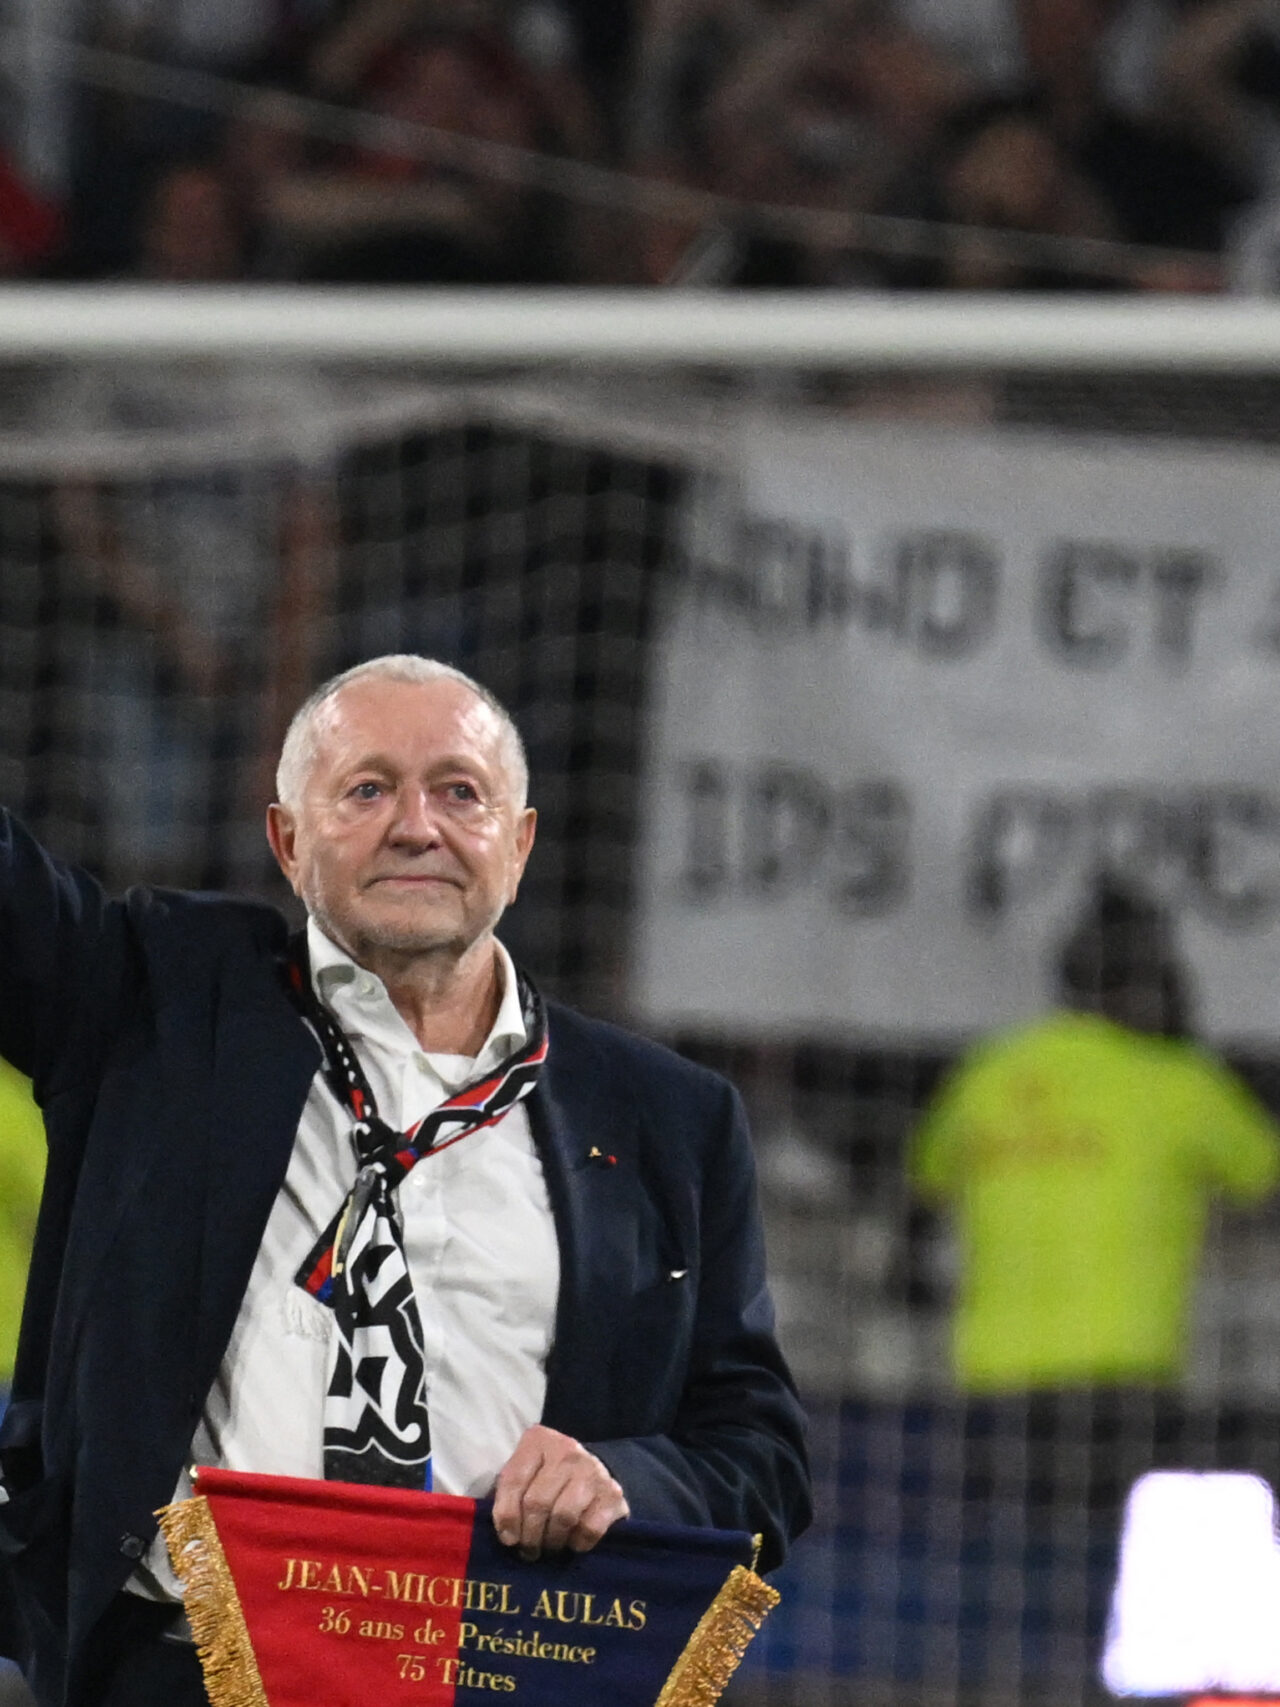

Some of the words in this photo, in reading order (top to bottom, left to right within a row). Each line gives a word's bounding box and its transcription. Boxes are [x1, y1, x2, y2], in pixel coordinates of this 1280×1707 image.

[278, 1558, 520, 1615] JEAN-MICHEL
[531, 1589, 648, 1631] AULAS
[318, 1607, 351, 1634] 36
[359, 1621, 405, 1641] ans
[414, 1620, 446, 1646] de
[458, 1622, 597, 1664] Présidence
[397, 1655, 426, 1681] 75
[437, 1658, 517, 1692] Titres
